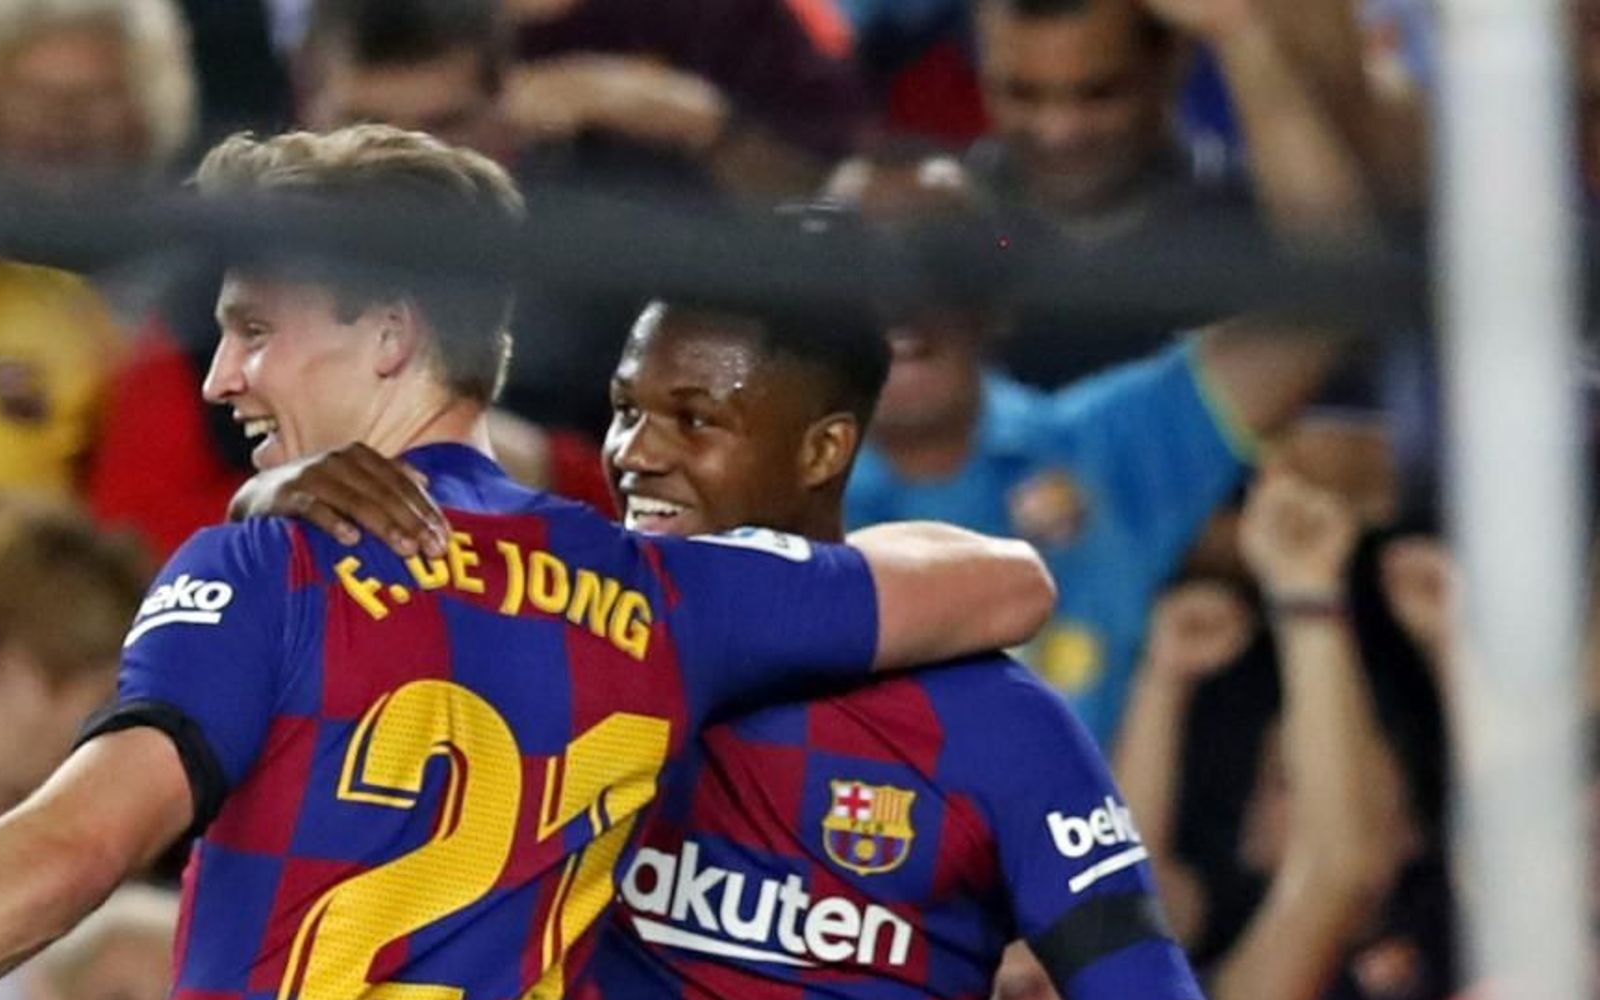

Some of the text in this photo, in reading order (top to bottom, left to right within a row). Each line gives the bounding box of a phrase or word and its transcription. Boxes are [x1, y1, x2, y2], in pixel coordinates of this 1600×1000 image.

[334, 556, 410, 621] F.
[496, 539, 652, 663] JONG
[617, 841, 913, 966] akuten
